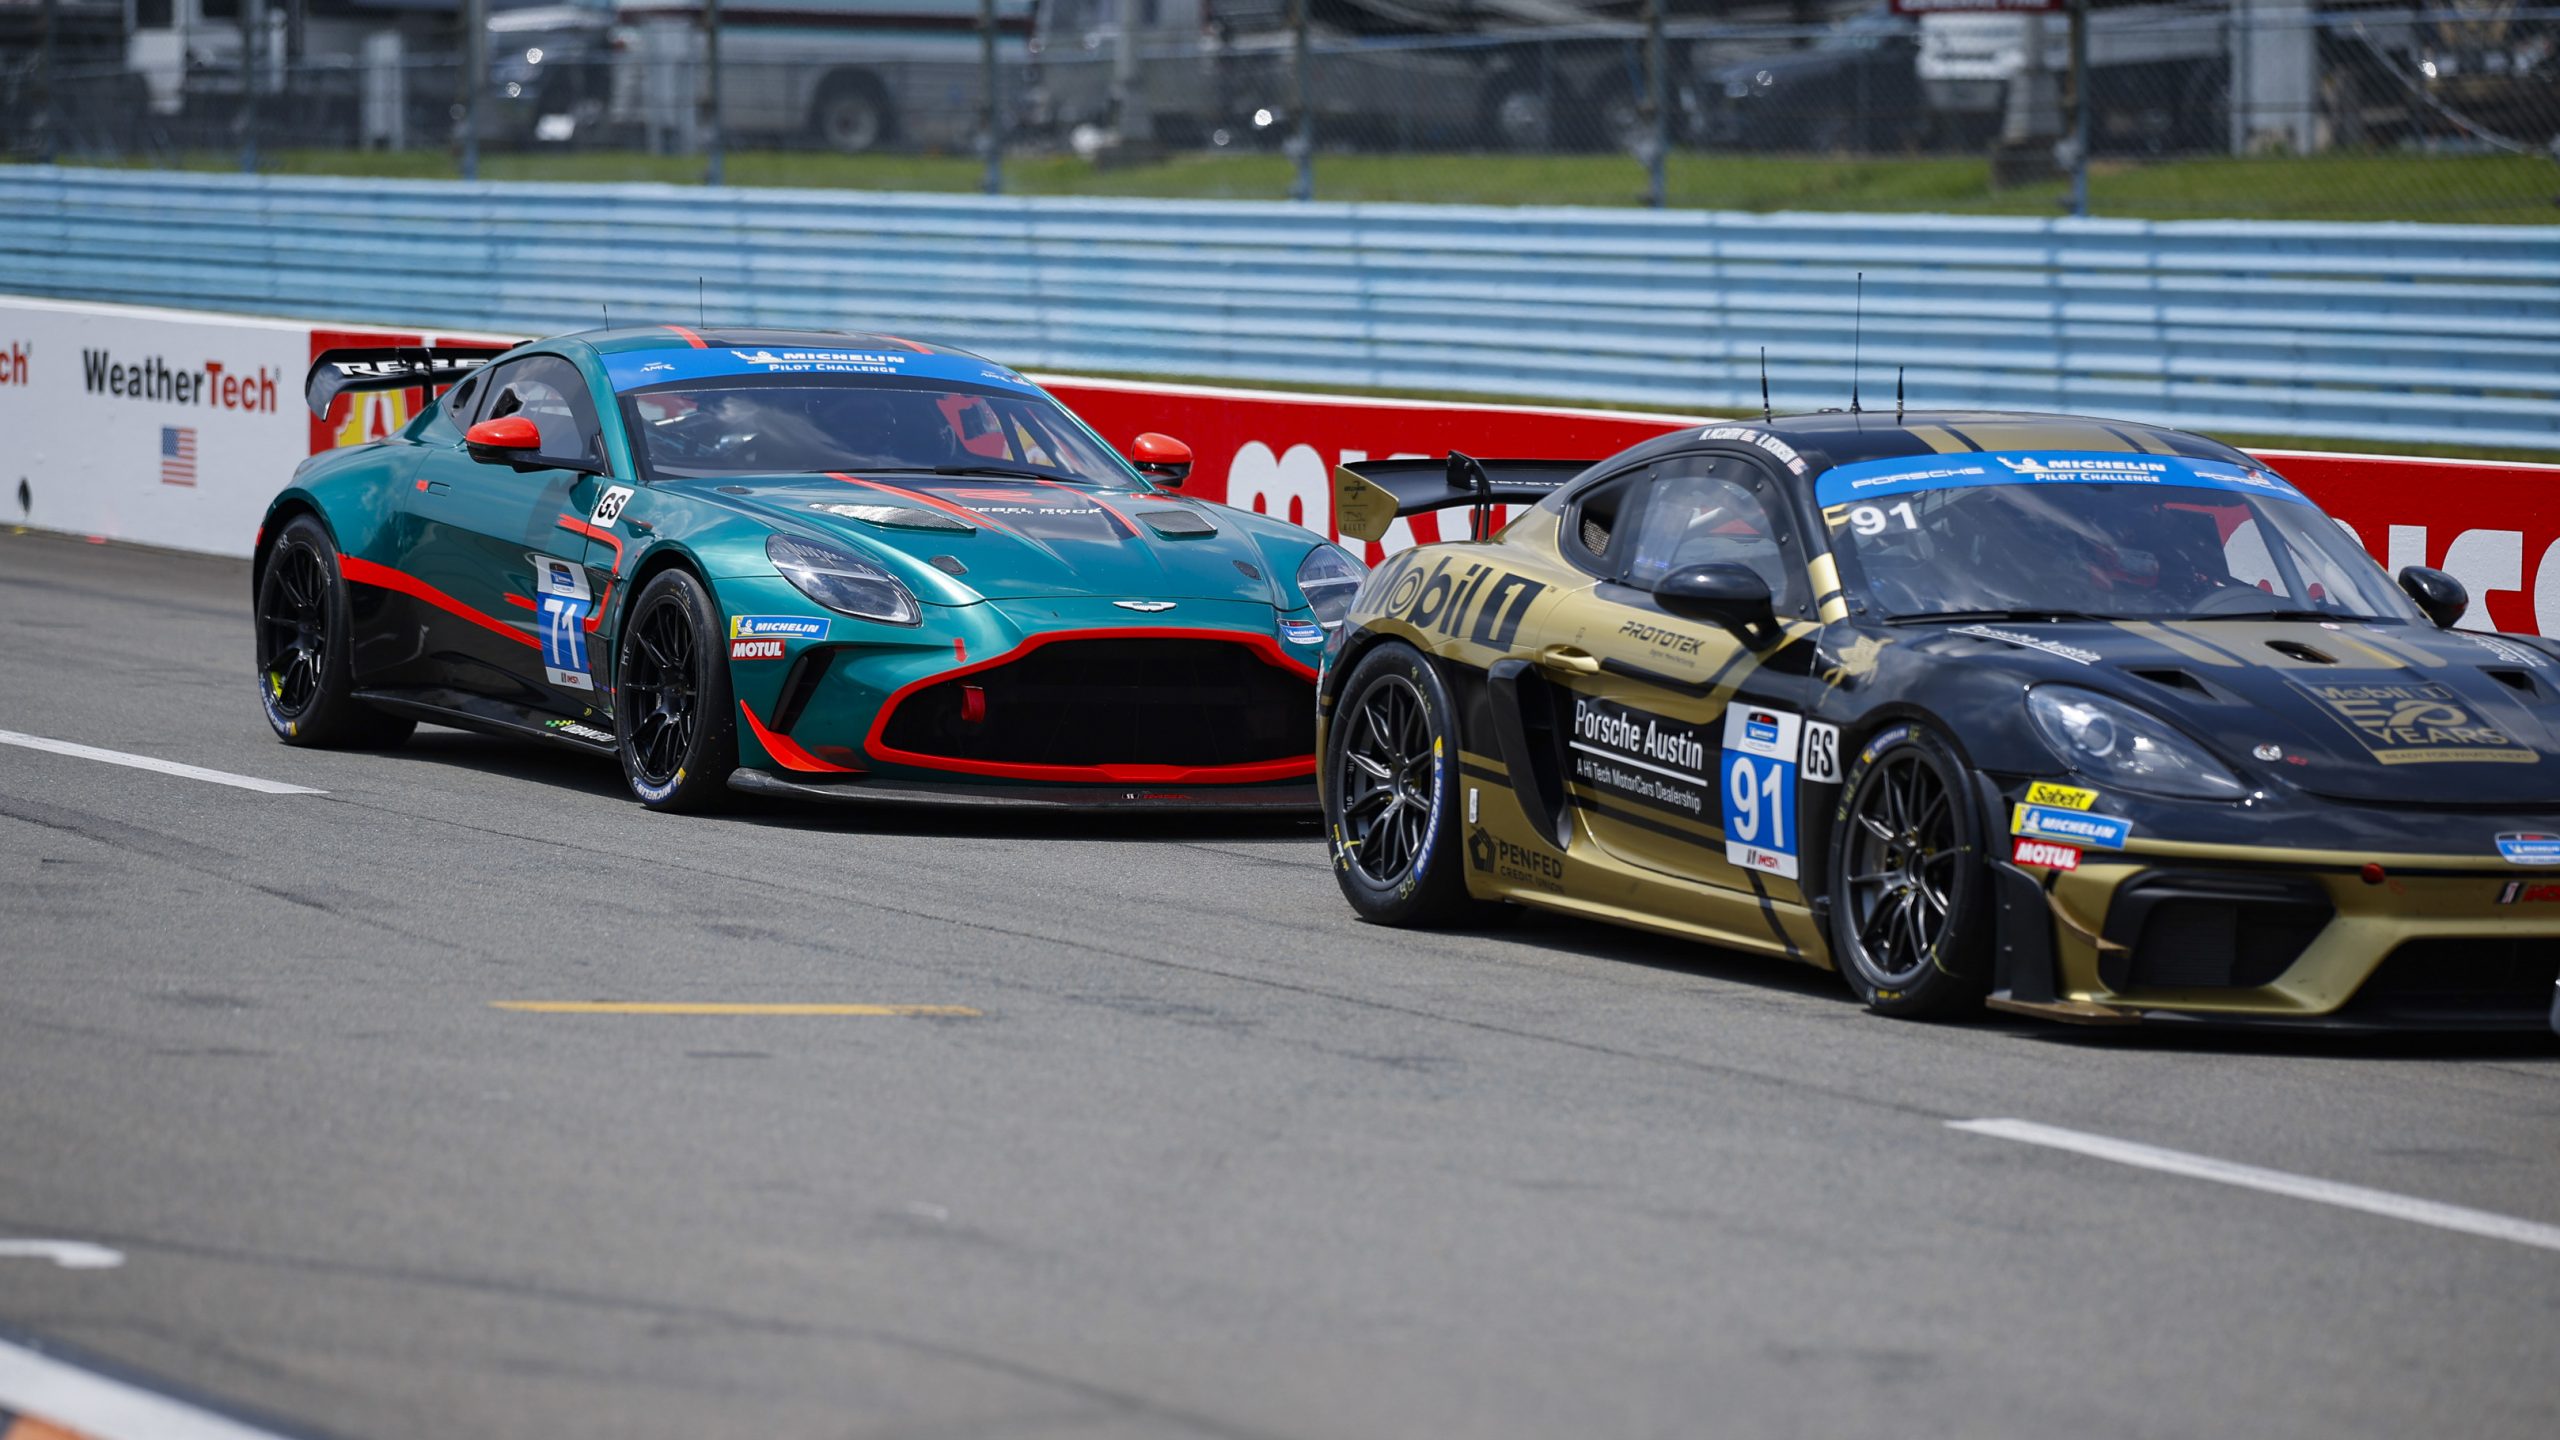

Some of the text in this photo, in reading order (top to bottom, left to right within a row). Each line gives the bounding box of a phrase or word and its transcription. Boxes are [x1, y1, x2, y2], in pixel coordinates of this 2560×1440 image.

[331, 358, 491, 377] REBE
[769, 363, 897, 374] PILOT CHALLENGE
[783, 353, 905, 364] MICHELIN
[83, 348, 278, 414] WeatherTech
[1851, 467, 1986, 489] PORSCHE
[2034, 472, 2161, 483] PILOT CHALLENGE
[2047, 459, 2167, 472] MICHELIN
[598, 491, 627, 521] GS
[1850, 501, 1918, 536] 91
[543, 597, 580, 670] 71
[755, 621, 820, 634] MICHELIN
[1618, 620, 1706, 656] PROTOTEK
[732, 641, 782, 658] MOTUL
[2314, 686, 2412, 700] Mobil
[1575, 699, 1703, 771] Porsche Austin
[2360, 727, 2511, 745] YEARS
[1807, 727, 1834, 779] GS
[1577, 758, 1583, 776] A
[1593, 763, 1612, 785] Tech
[1655, 781, 1702, 815] Dealership
[1730, 757, 1784, 848] 91
[1417, 779, 1442, 874] MICHELIN
[2040, 816, 2118, 839] MICHELIN
[1500, 840, 1563, 880] PENFED
[2015, 842, 2077, 869] MOTUL
